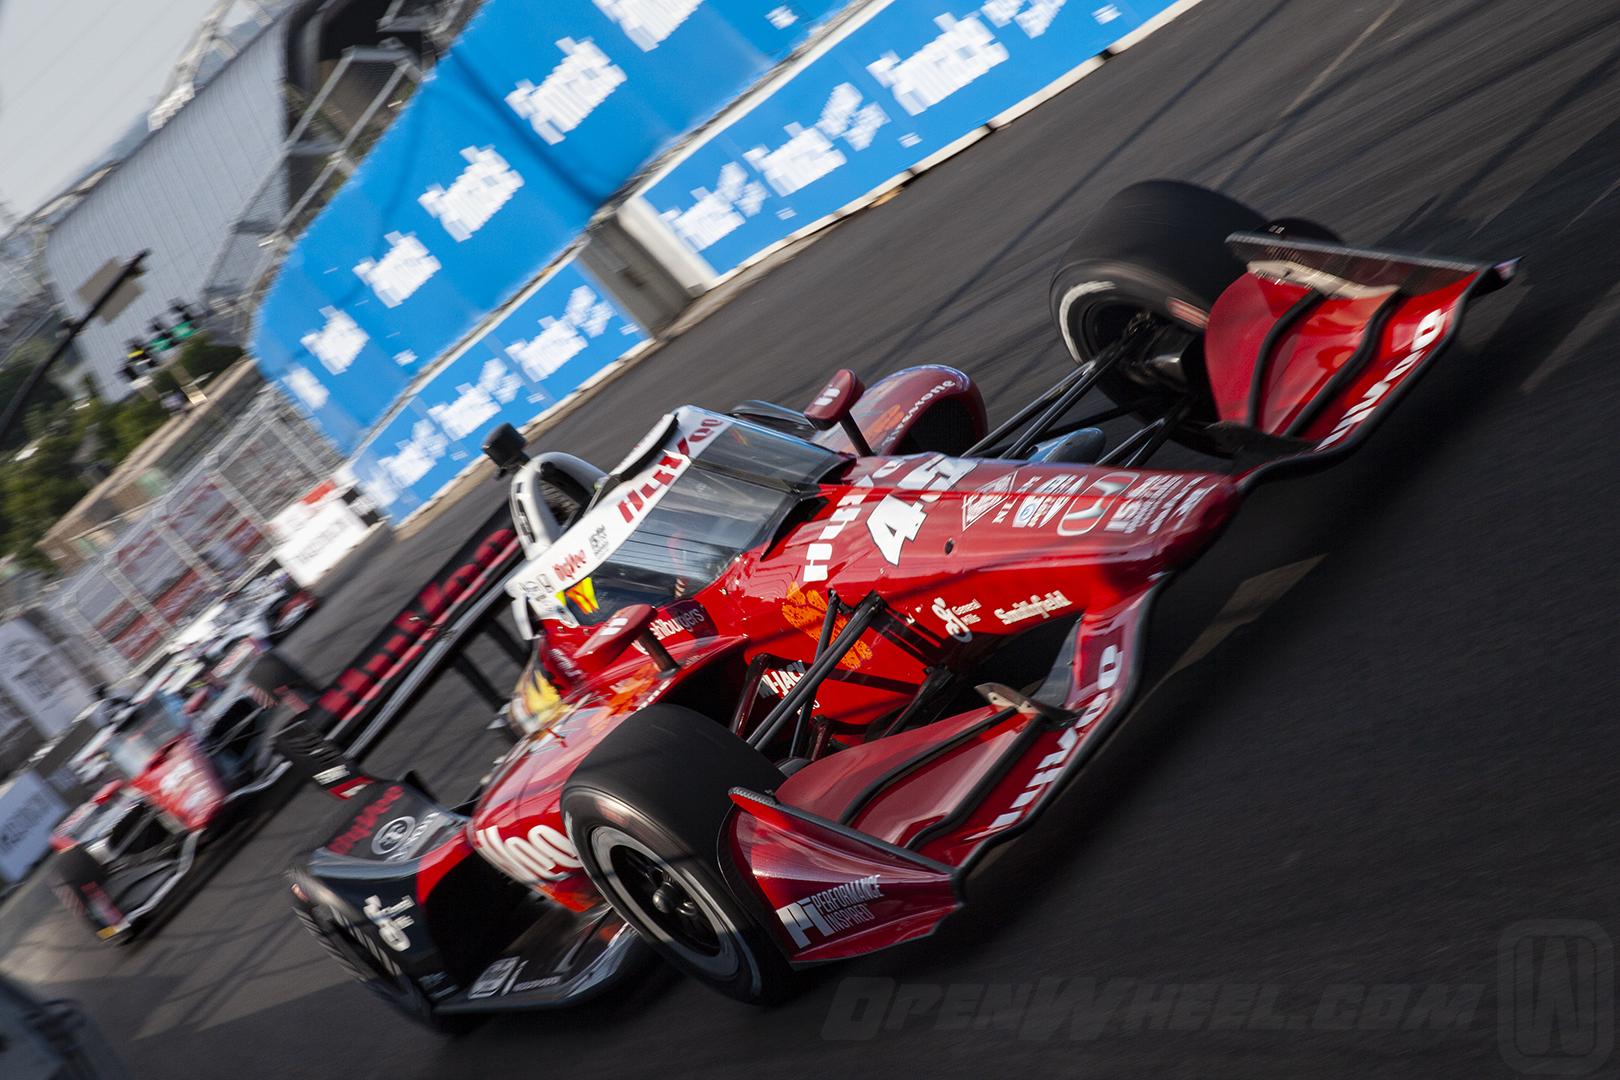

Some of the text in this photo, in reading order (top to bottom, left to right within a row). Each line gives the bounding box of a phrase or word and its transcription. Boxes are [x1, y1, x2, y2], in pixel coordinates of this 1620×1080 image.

[866, 452, 979, 567] 45
[951, 599, 983, 616] General
[993, 589, 1074, 626] Smithfield
[631, 606, 705, 656] ahlburgers
[810, 873, 885, 914] PERFORMANCE
[823, 903, 876, 933] INSPIRED
